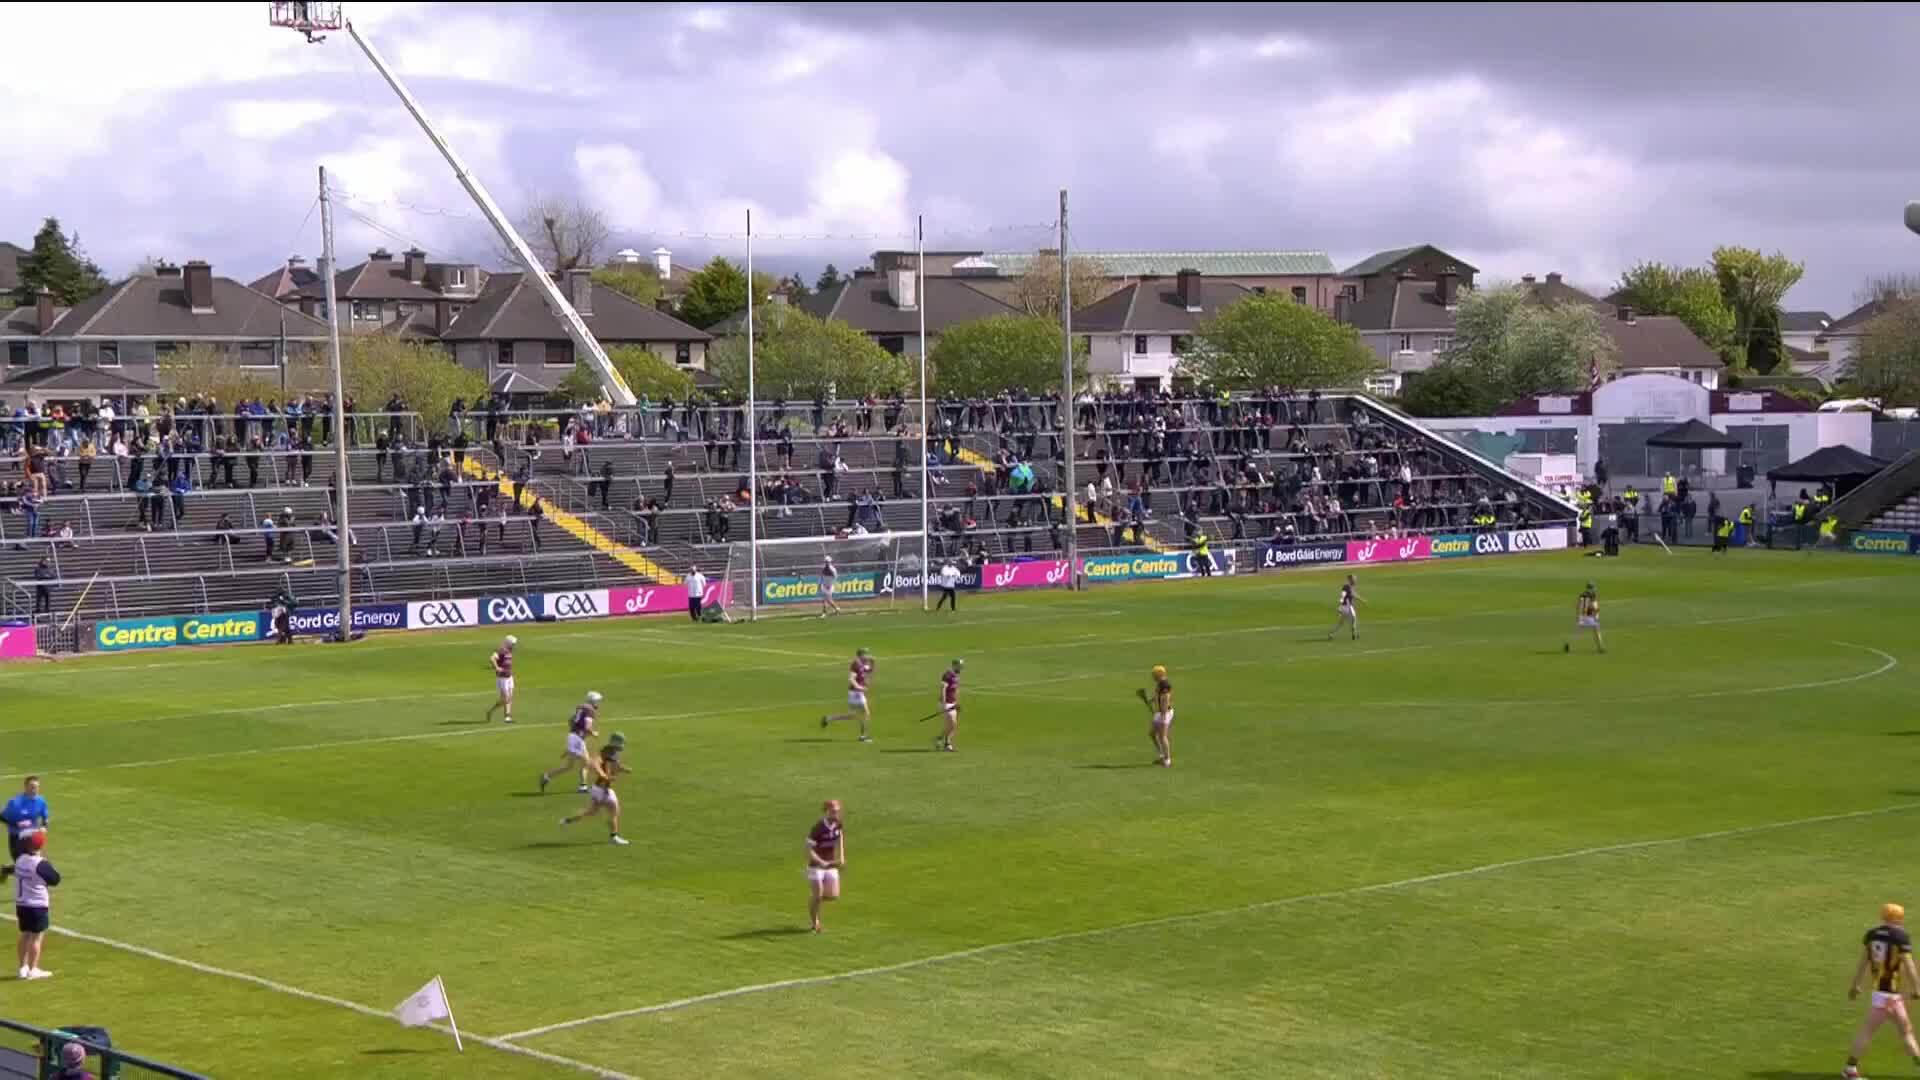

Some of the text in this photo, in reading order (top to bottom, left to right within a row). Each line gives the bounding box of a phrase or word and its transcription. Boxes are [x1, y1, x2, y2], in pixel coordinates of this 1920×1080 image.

[1432, 539, 1470, 554] Centra
[1476, 535, 1503, 553] GAA
[1275, 550, 1296, 562] Bord
[1315, 547, 1343, 560] Energy
[1084, 561, 1129, 576] Centra
[1132, 559, 1178, 574] Centra
[766, 580, 818, 599] Centra
[895, 574, 920, 588] Bord
[555, 593, 597, 616] GAA
[626, 588, 655, 612] eir
[354, 610, 401, 626] Energy
[419, 602, 465, 626] GAA
[488, 597, 535, 622] GAA
[100, 624, 177, 646] Centra
[183, 619, 256, 640] Centra
